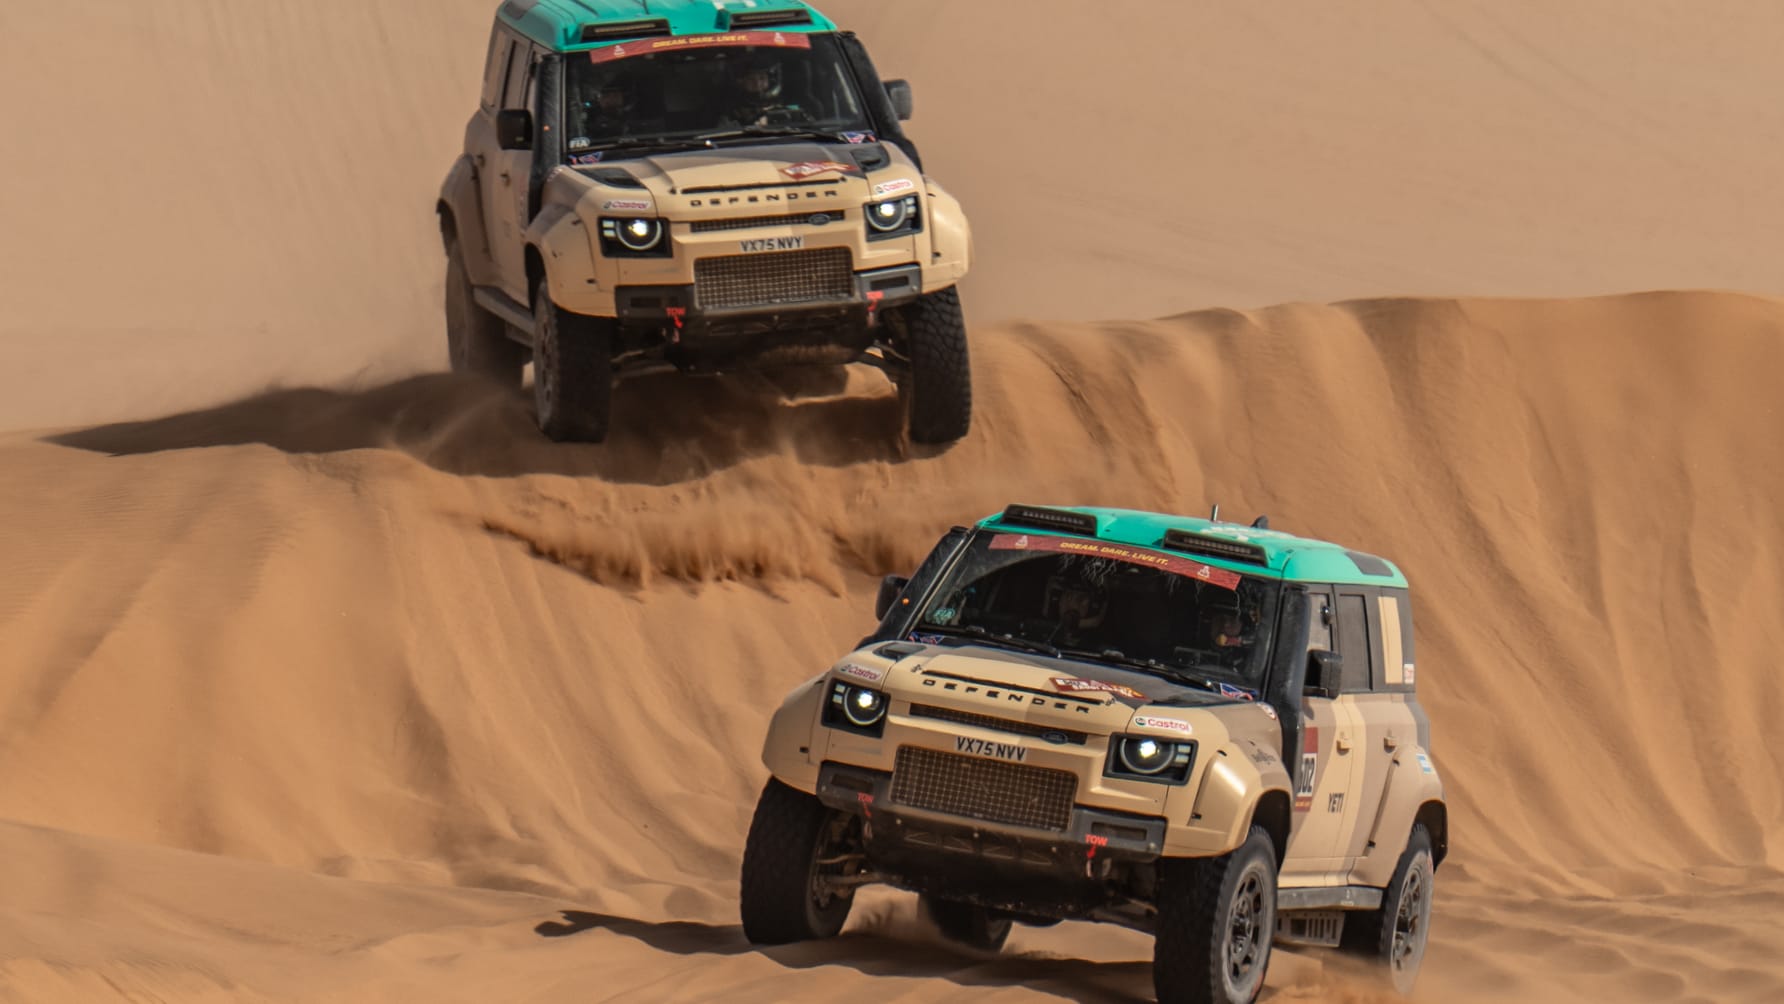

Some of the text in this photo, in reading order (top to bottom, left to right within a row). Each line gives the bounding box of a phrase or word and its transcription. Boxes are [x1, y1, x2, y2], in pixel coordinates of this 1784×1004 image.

[690, 189, 838, 207] DEFENDER
[741, 236, 803, 252] VX75 NVY
[1060, 542, 1169, 566] DREAM. DARE. LIVE IT.
[848, 666, 881, 681] Castrol
[922, 679, 1089, 713] DEFENDER
[1147, 718, 1190, 732] Castrol
[956, 736, 1026, 761] VX75 NVV
[857, 792, 874, 804] TOW
[1328, 793, 1344, 813] YETI
[1085, 834, 1108, 847] TOW
